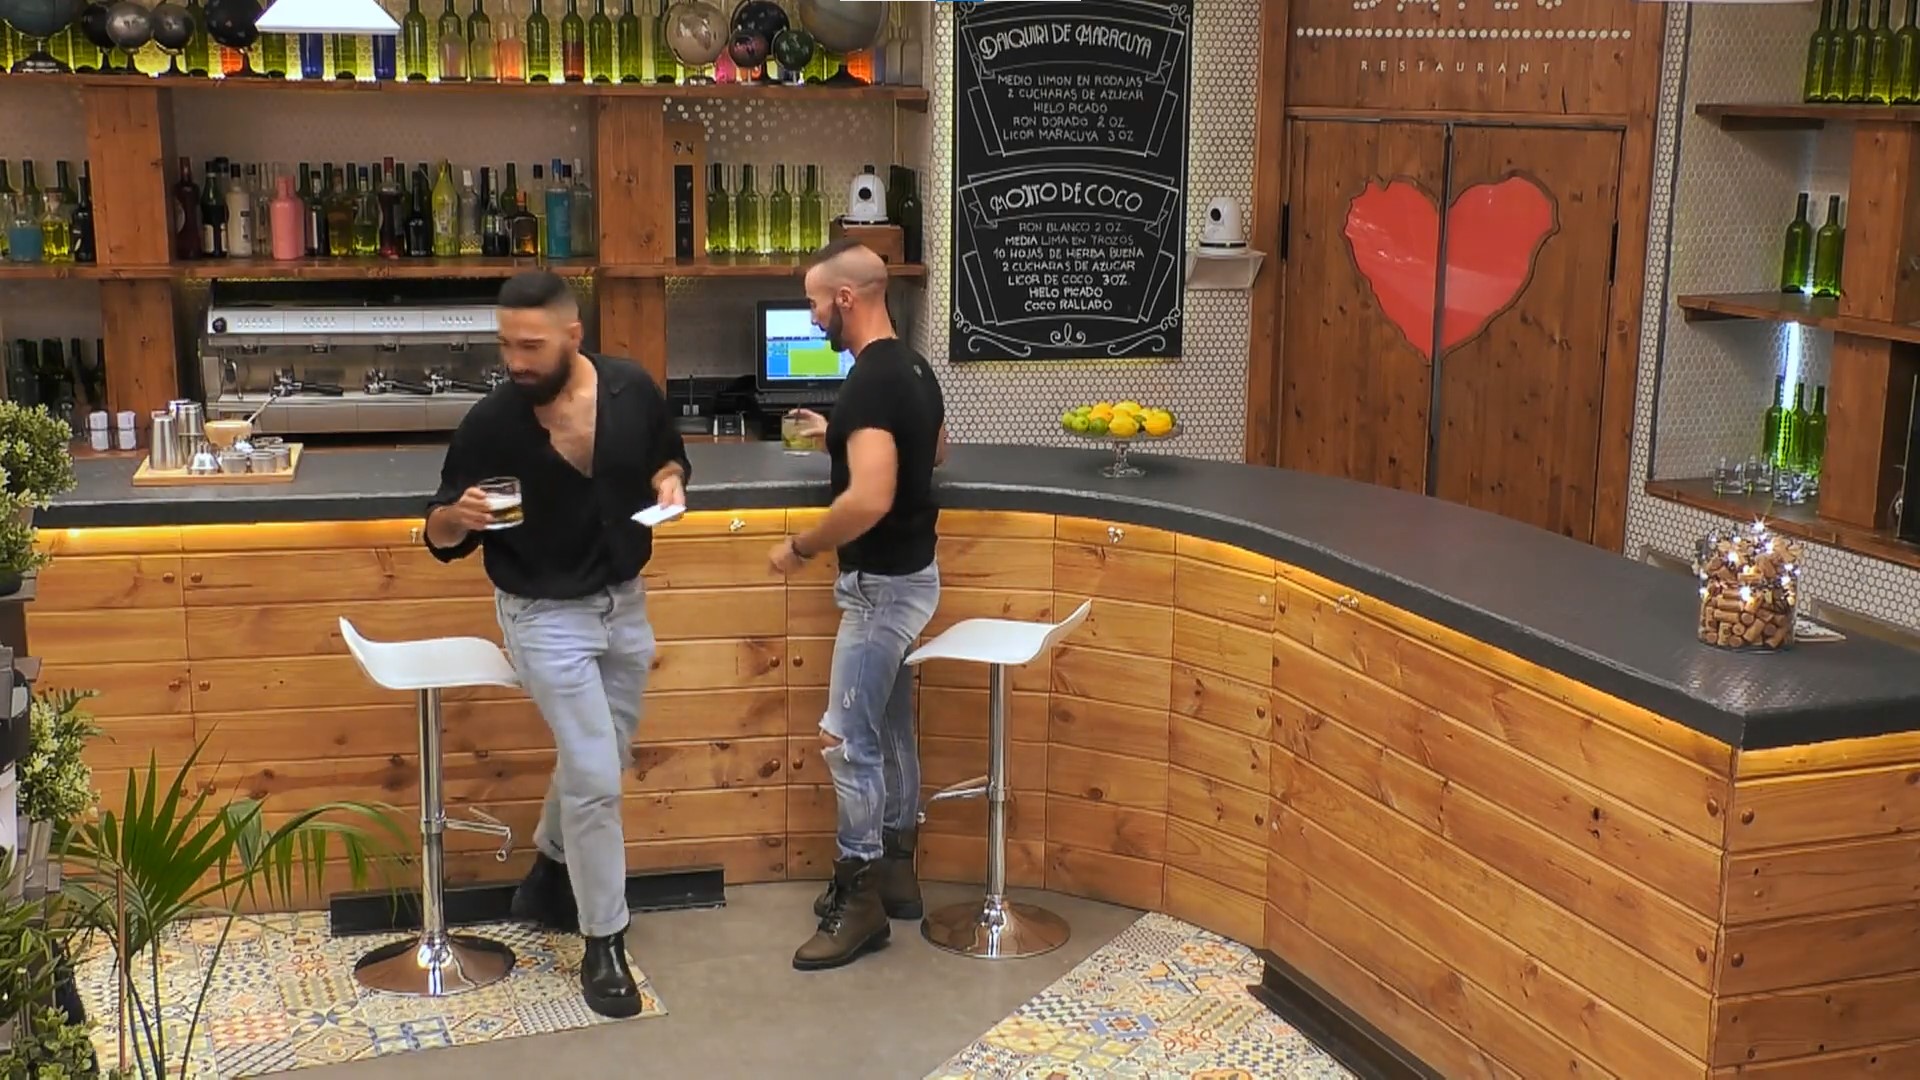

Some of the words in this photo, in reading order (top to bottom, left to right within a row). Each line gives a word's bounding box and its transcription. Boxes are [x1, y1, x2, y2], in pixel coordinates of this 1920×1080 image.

[979, 24, 1049, 60] DAIQUIRI
[1052, 24, 1072, 43] DE
[1075, 24, 1152, 58] MARACUYA
[1361, 60, 1550, 74] RESTAURANT
[998, 75, 1032, 85] MEDIO
[1038, 75, 1071, 86] LIMON
[1077, 76, 1090, 86] EN
[1095, 75, 1143, 87] RODAJAS
[1008, 89, 1014, 98] 2
[1019, 89, 1077, 100] CUCHARAS
[1082, 90, 1095, 100] DE
[1100, 90, 1144, 100] AZUCAR
[1034, 103, 1064, 113] HIELO
[1068, 103, 1107, 113] PICADO
[1013, 117, 1036, 127] RON
[1042, 116, 1088, 127] DORADO
[1097, 116, 1105, 127] 2
[1003, 129, 1034, 140] LICOR
[1039, 130, 1098, 142] MARACUYA
[990, 183, 1057, 215] MOJITO
[1062, 183, 1081, 203] DE
[1085, 184, 1143, 212] COCO
[1019, 222, 1042, 232] RON
[1047, 222, 1090, 232] BLANCO
[1095, 222, 1101, 232] 2
[1005, 236, 1038, 246] MEDIA
[1041, 236, 1068, 245] LIMA
[1072, 236, 1086, 245] EN
[1091, 235, 1134, 245] TROZOS
[993, 248, 1005, 259] 10
[1010, 248, 1044, 259] HOJAS
[1049, 248, 1062, 259] DE
[1110, 247, 1144, 258] BUENA
[1002, 262, 1009, 272] 2
[1013, 261, 1071, 272] CUCHARAS
[1075, 261, 1088, 271] DE
[1092, 261, 1135, 271] AZUCAR
[1008, 274, 1040, 286] LICOR
[1044, 274, 1059, 285] DE
[1062, 274, 1093, 284] COCO
[1029, 287, 1060, 298] HIELO
[1064, 287, 1103, 298] PICADO
[1024, 301, 1056, 312] COCO
[1060, 300, 1112, 311] RALLADO
